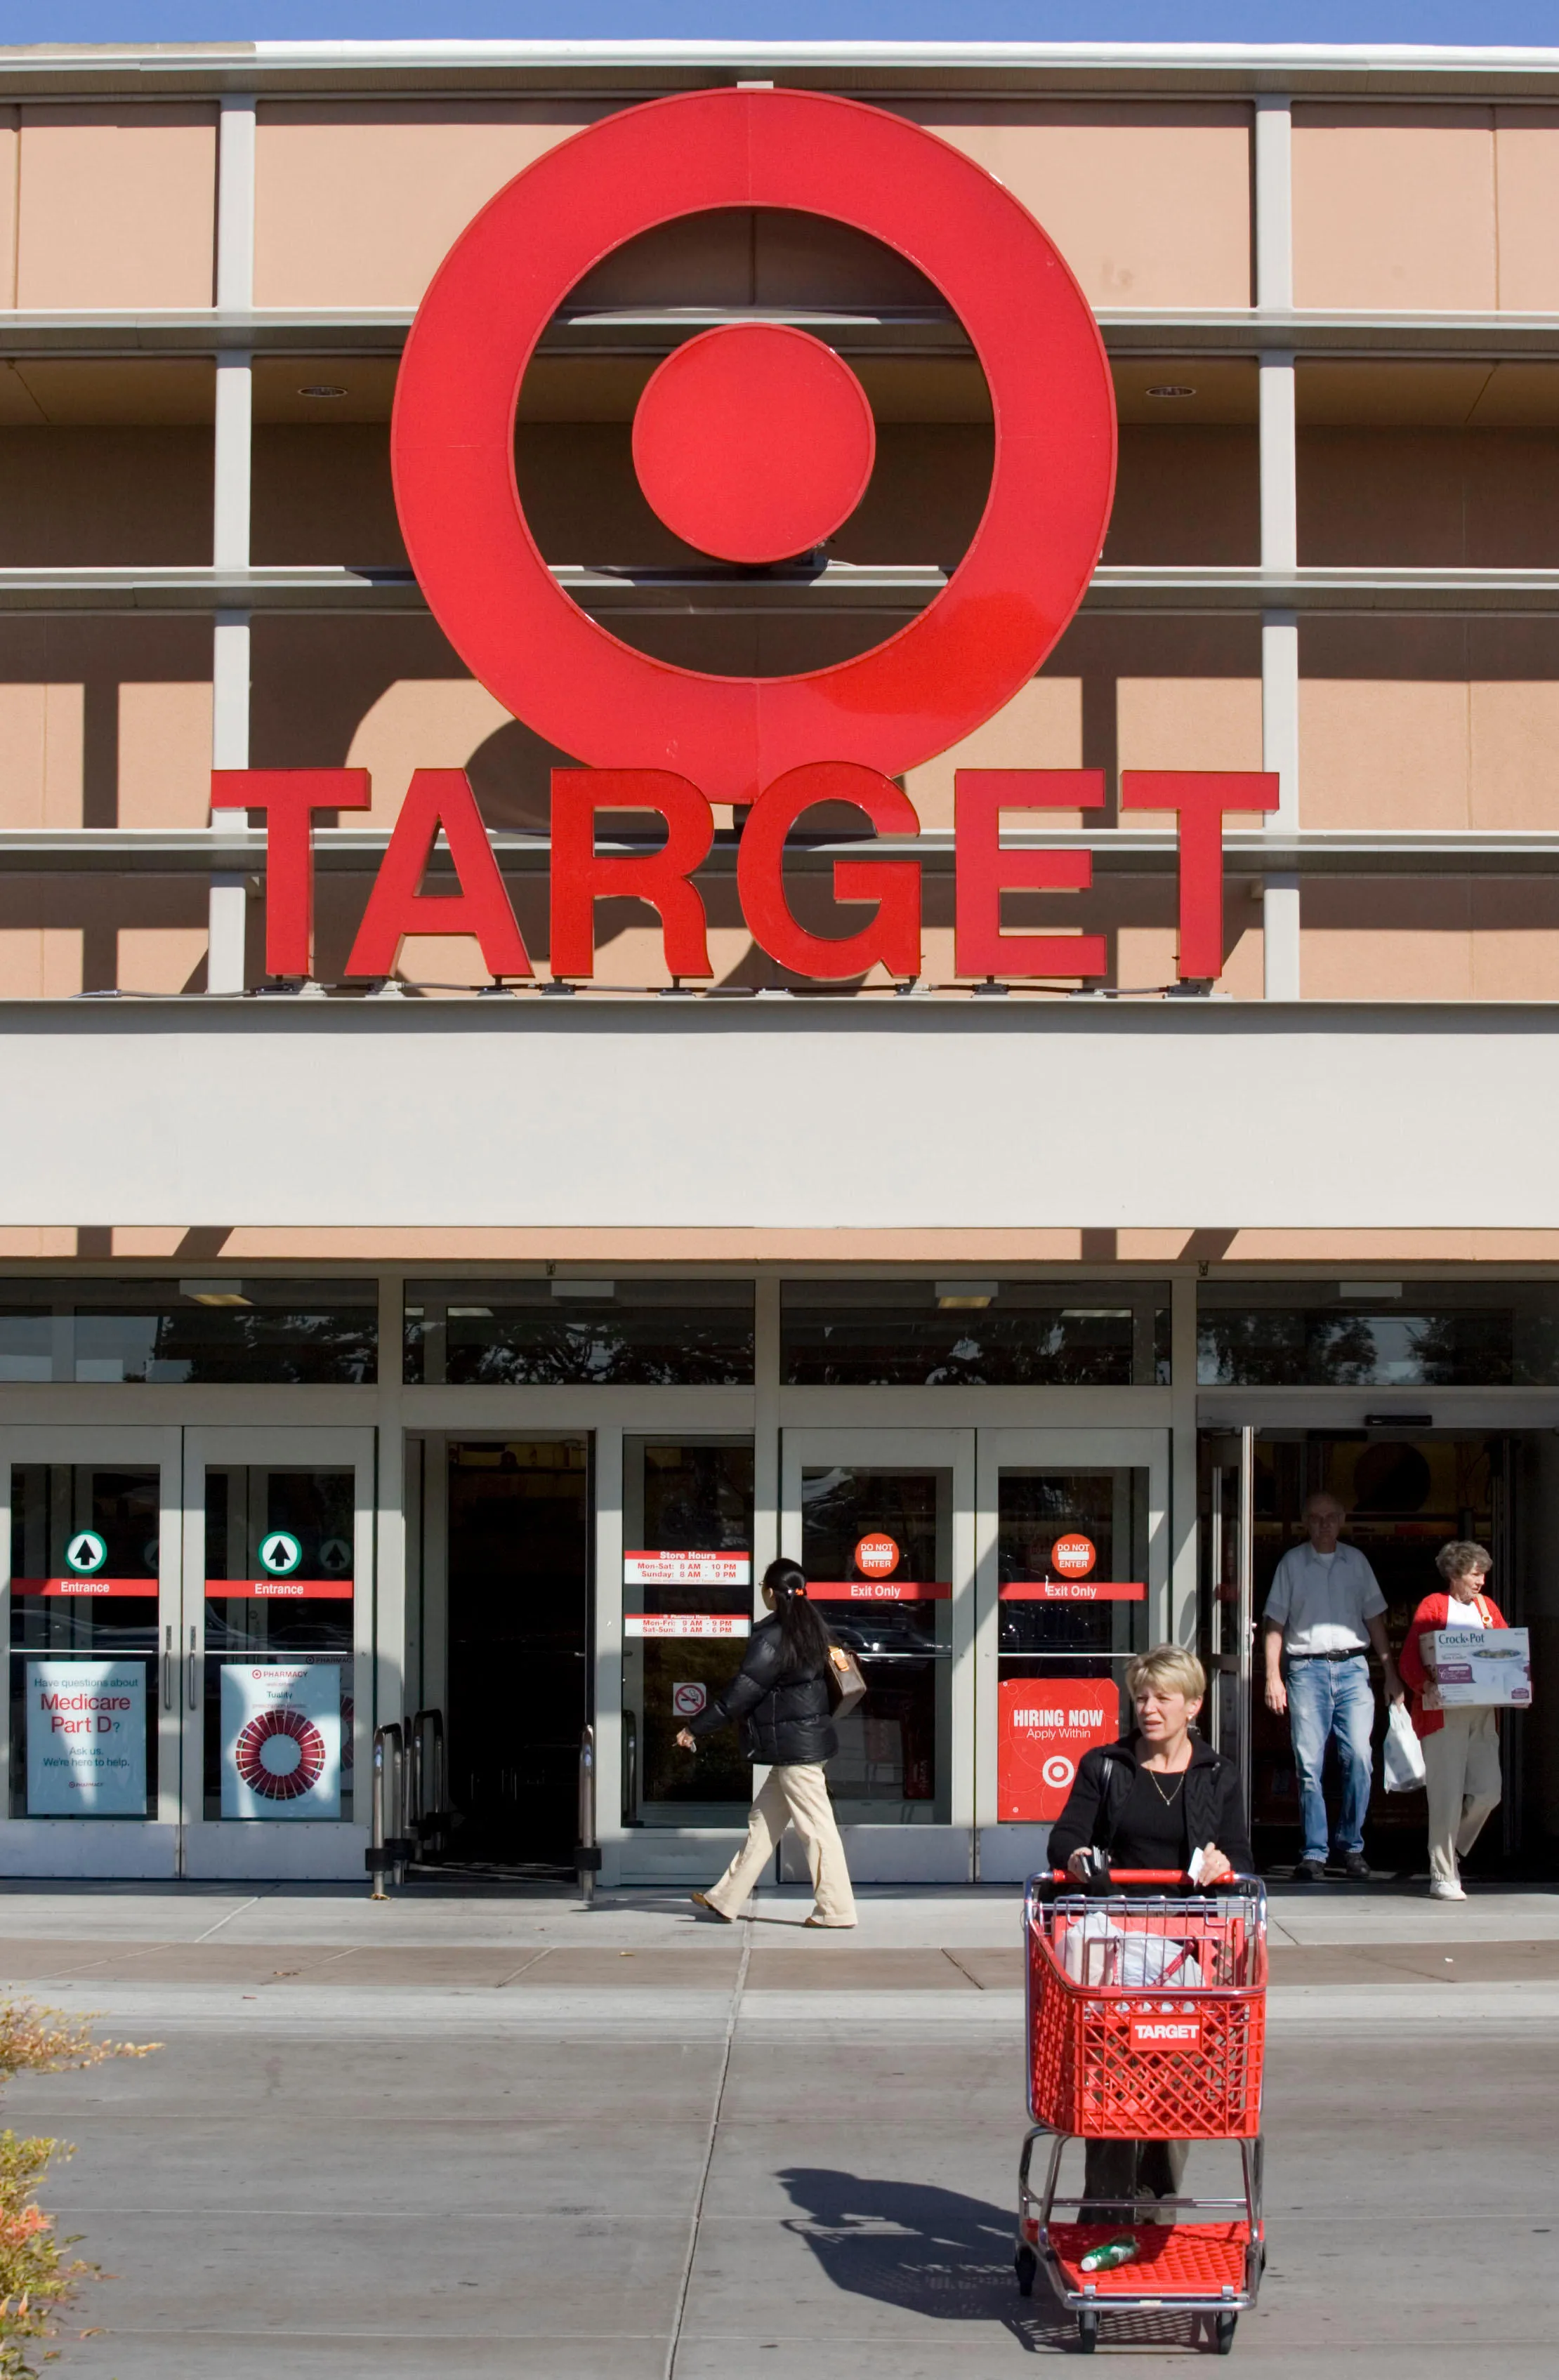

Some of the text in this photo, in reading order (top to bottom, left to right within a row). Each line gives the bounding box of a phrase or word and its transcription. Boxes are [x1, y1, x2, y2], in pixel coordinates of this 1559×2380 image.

[211, 760, 1280, 981] TARGET
[659, 1551, 716, 1560] Store Hours
[60, 1582, 110, 1593] Entrance
[254, 1583, 304, 1594] Entrance
[850, 1585, 901, 1599] Exit Only
[1046, 1585, 1097, 1599] Exit Only
[62, 1679, 109, 1688] questions
[41, 1693, 131, 1711] Medicare
[51, 1716, 120, 1733] Part D?
[1013, 1710, 1103, 1727] HIRING NOW
[1026, 1728, 1091, 1740] Apply Within
[69, 1747, 104, 1756] Ask us.
[43, 1757, 130, 1769] We're here to help.
[1135, 2024, 1200, 2039] TARGET
